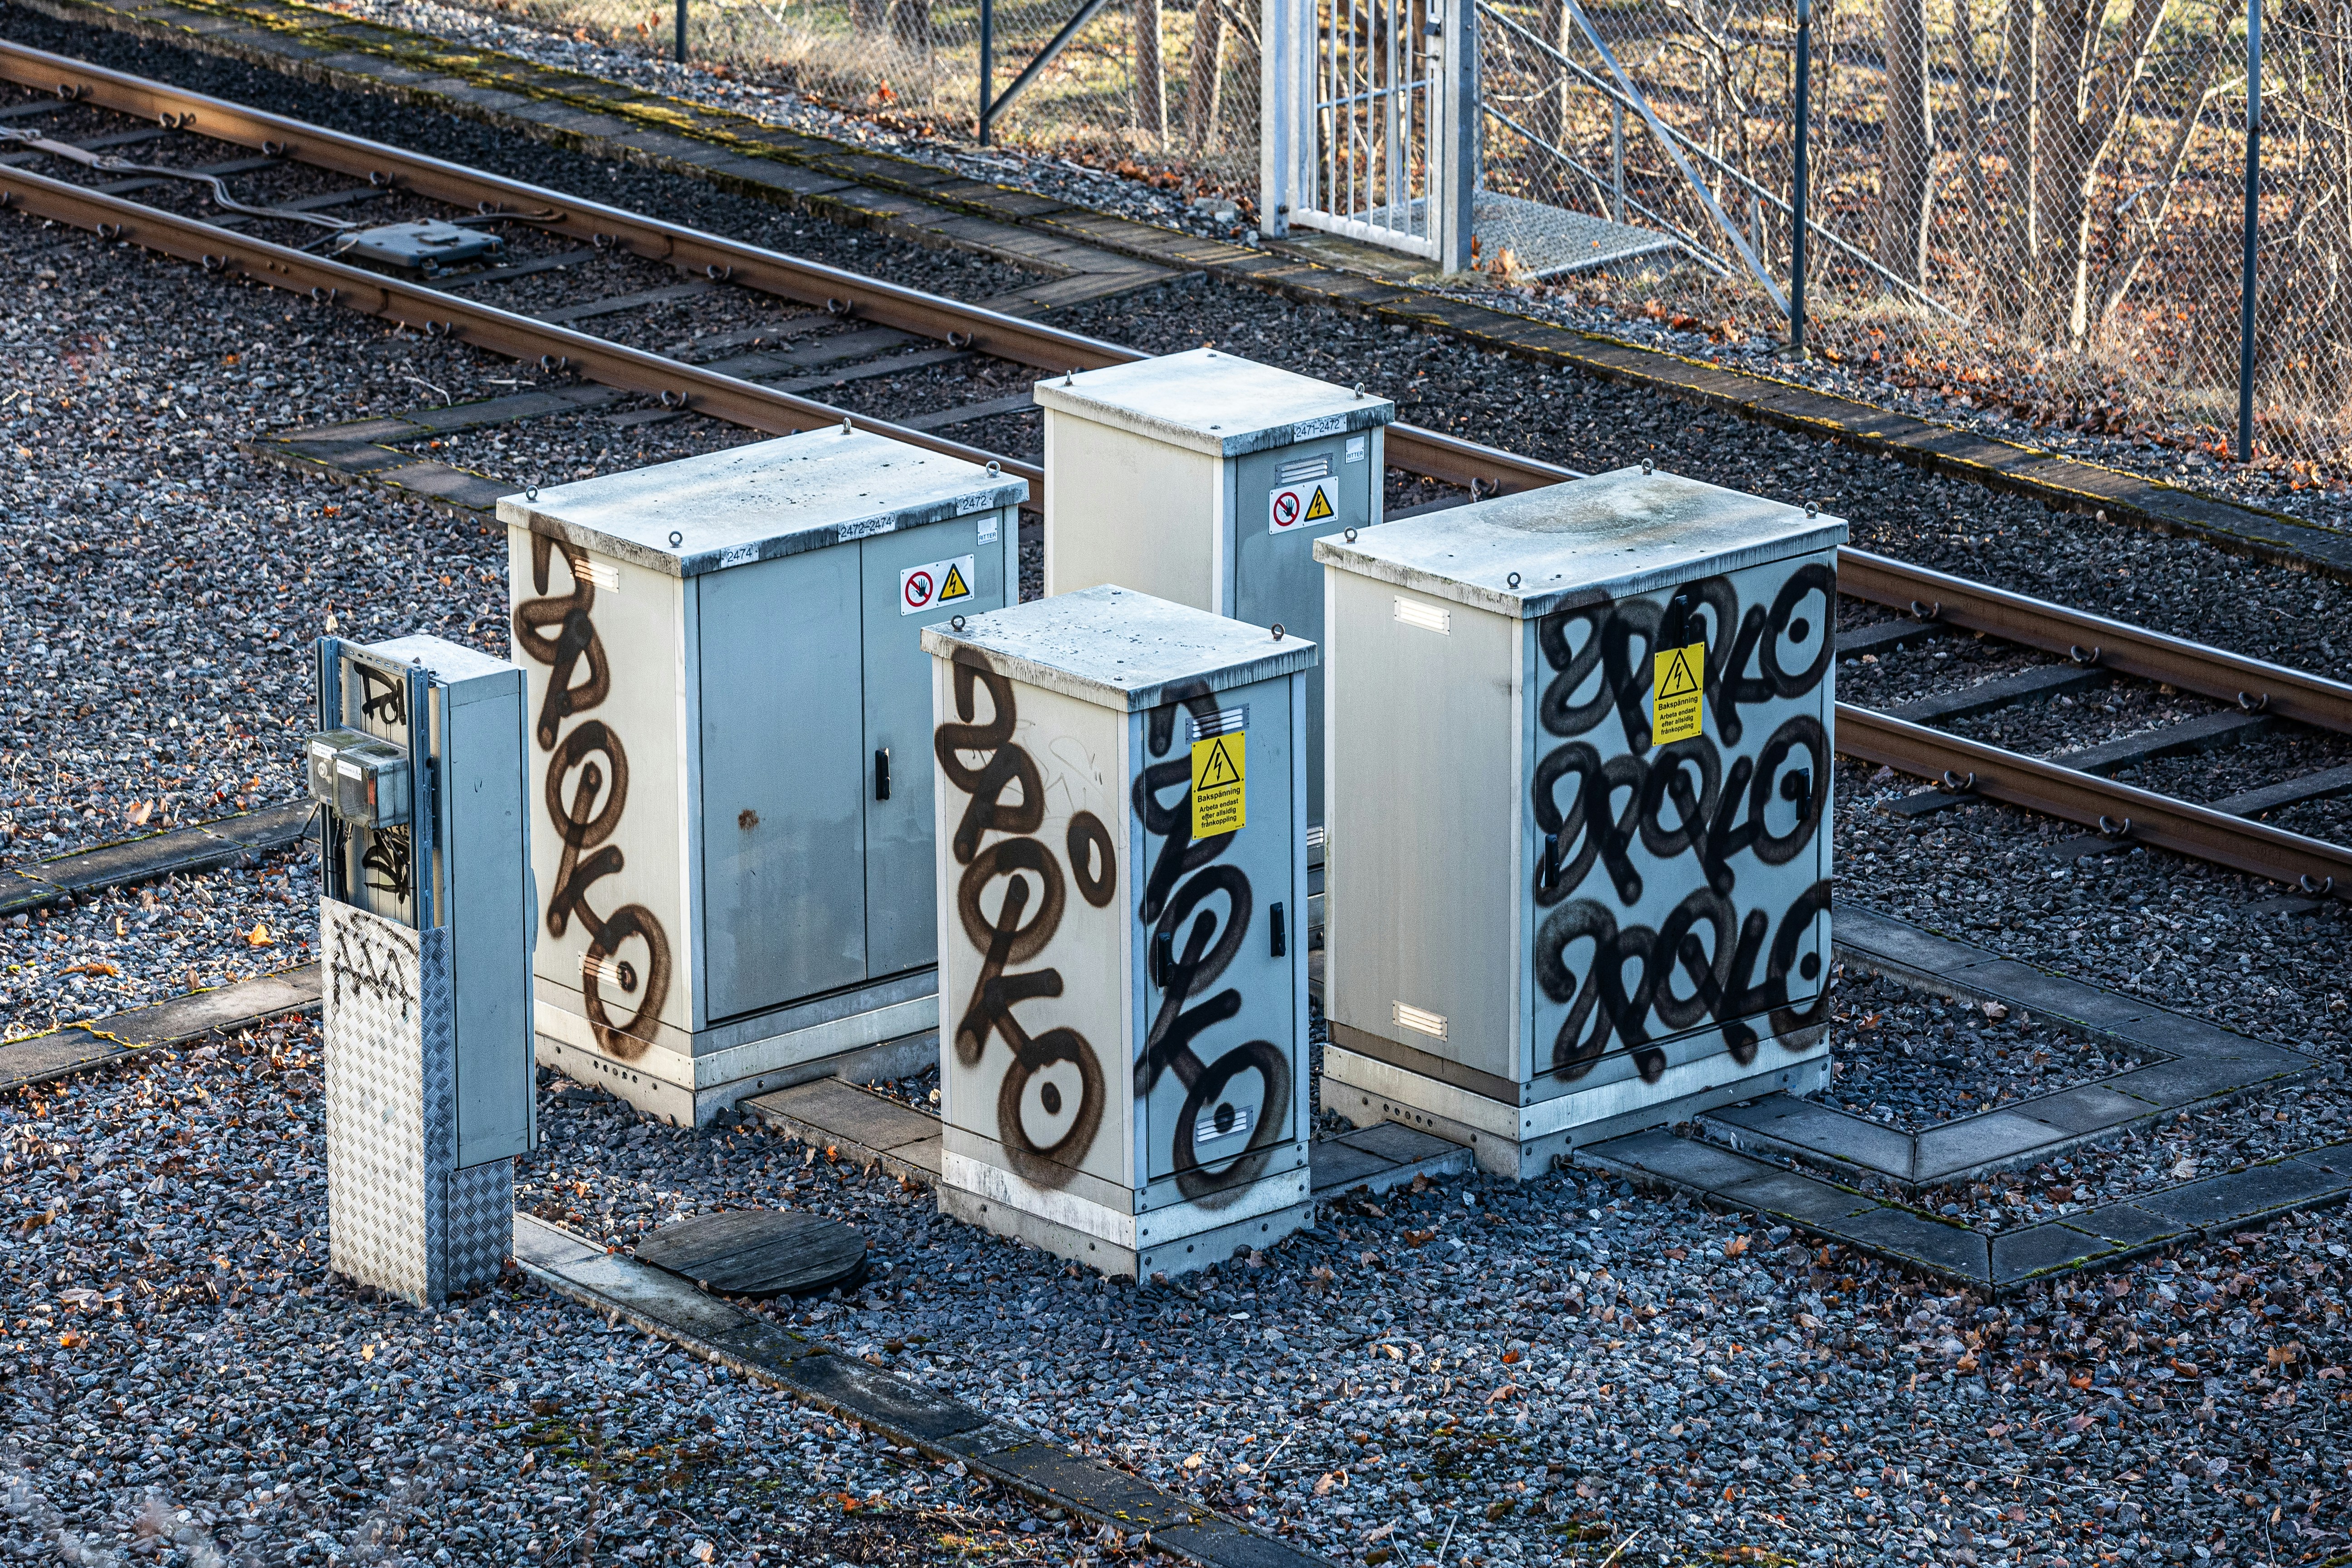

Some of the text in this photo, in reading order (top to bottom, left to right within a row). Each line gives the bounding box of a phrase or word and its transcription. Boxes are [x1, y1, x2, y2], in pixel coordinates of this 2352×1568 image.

[1296, 419, 1340, 437] 2471-2472
[962, 495, 986, 510] 2472
[840, 516, 892, 538] 2472-2474
[979, 532, 996, 541] RITTER
[727, 547, 752, 562] 2474
[1658, 696, 1698, 711] Bakspänning
[1659, 706, 1696, 721] Arbeta endast
[1675, 715, 1693, 724] allsidig
[1661, 723, 1694, 735] frånkoppling
[1197, 787, 1240, 803] Bakspänning
[1199, 798, 1239, 813] Arbeta endast
[1216, 807, 1236, 817] allsidig
[1201, 815, 1237, 828] frånkoppling
